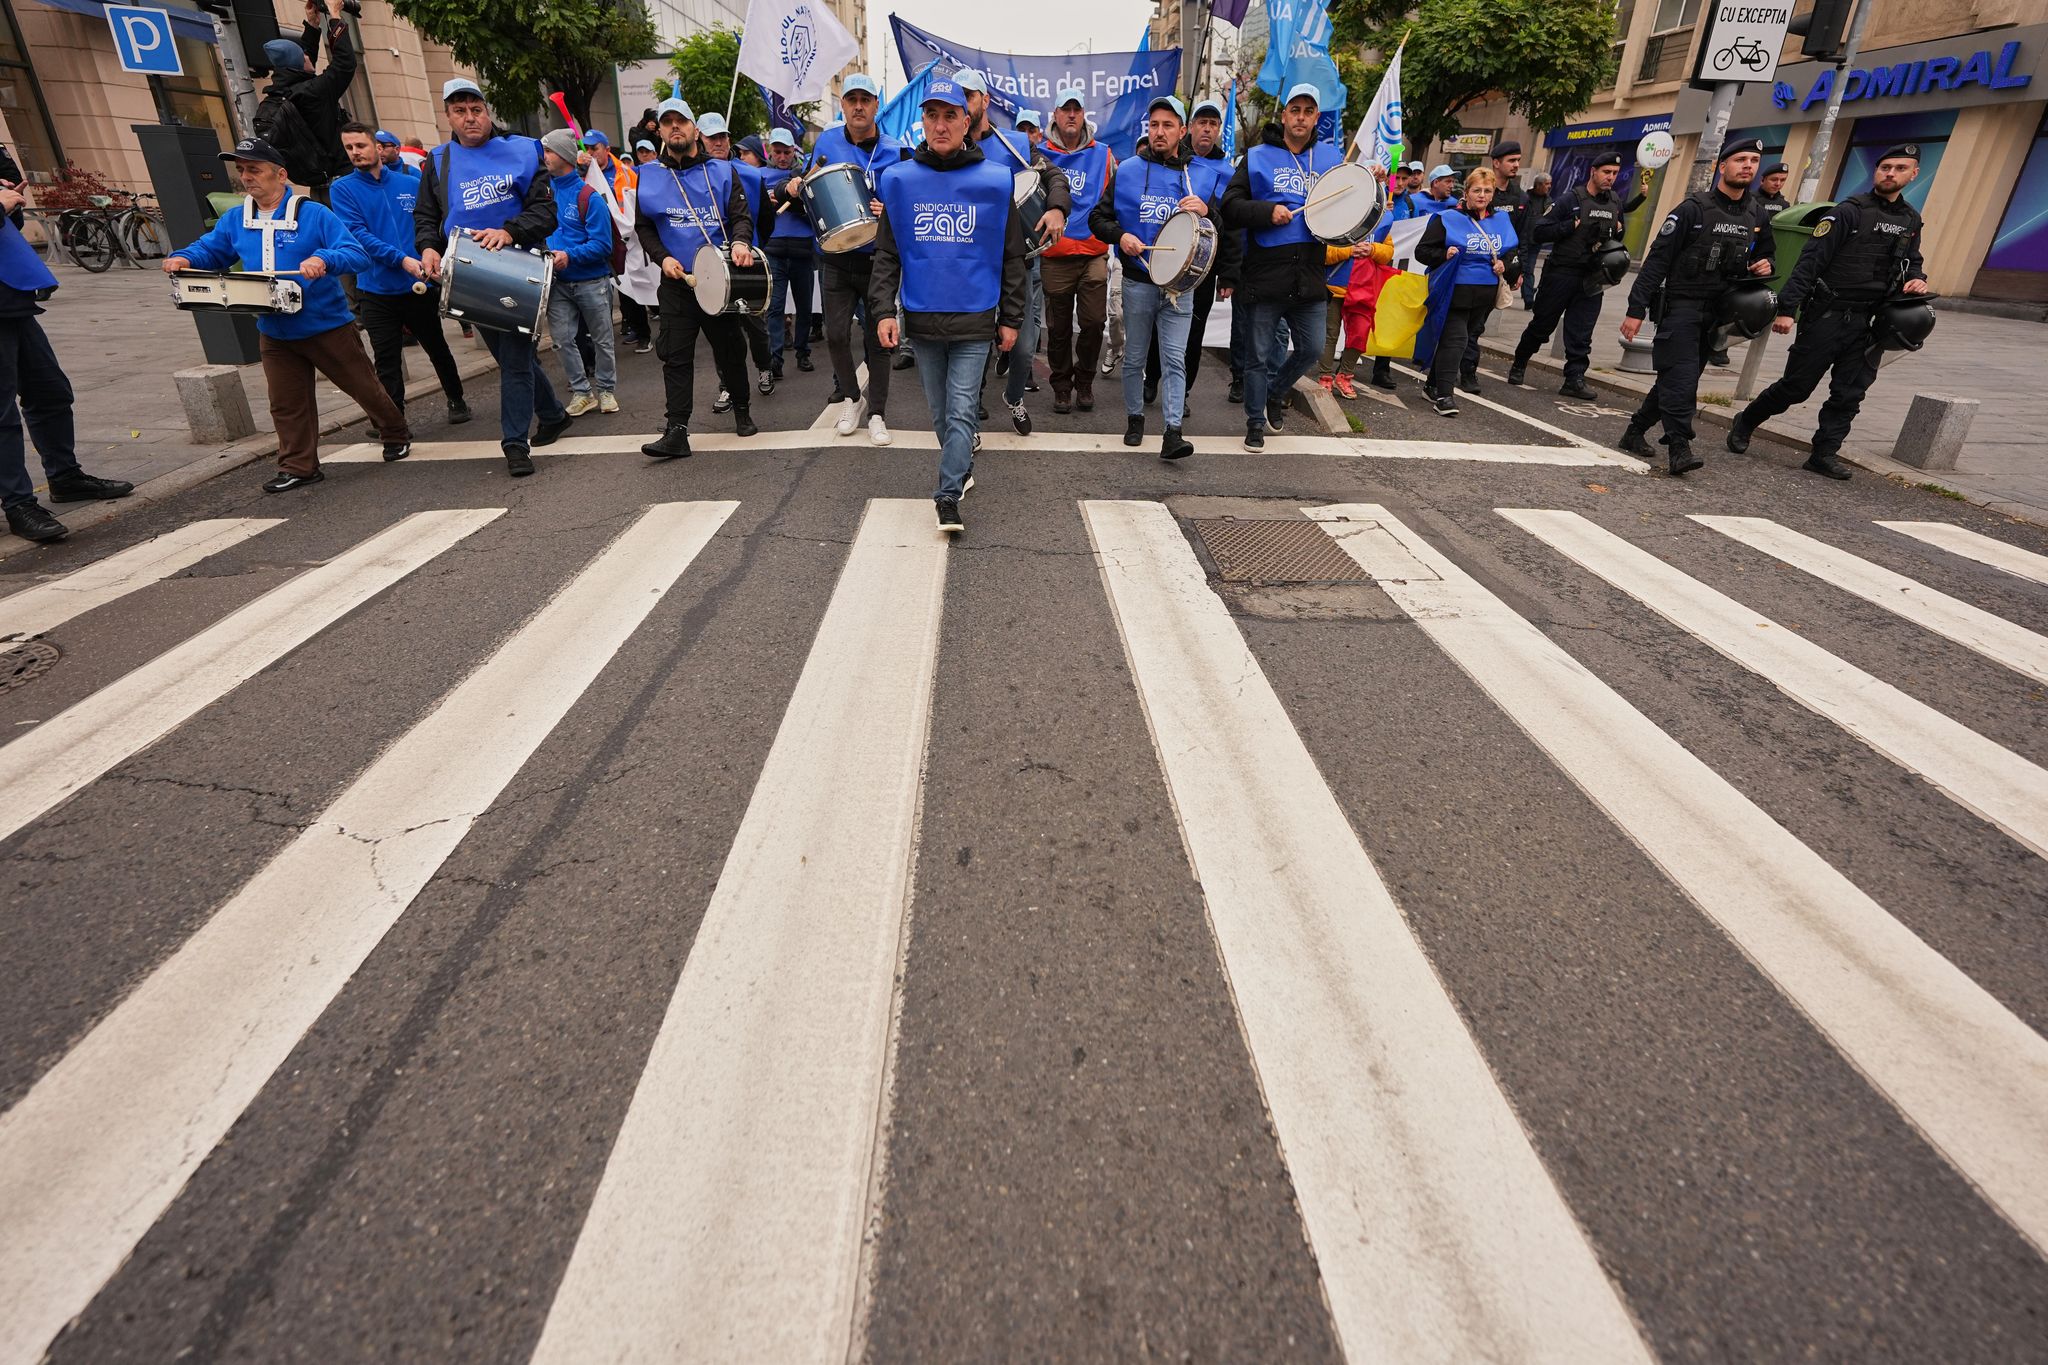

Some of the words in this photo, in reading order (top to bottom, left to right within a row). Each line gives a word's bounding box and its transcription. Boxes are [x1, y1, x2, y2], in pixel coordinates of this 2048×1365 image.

[1720, 7, 1736, 22] CU
[1737, 8, 1787, 24] EXCEPTIA
[121, 16, 160, 63] P
[1056, 71, 1085, 97] de
[1801, 41, 2032, 111] ADMIRAL
[1653, 147, 1671, 157] loto
[460, 174, 502, 189] SINDICATUL
[465, 197, 500, 211] AUTOTURISME
[501, 194, 515, 203] DACIA
[1141, 194, 1178, 205] SINDICATU
[914, 204, 965, 213] SINDICATUL
